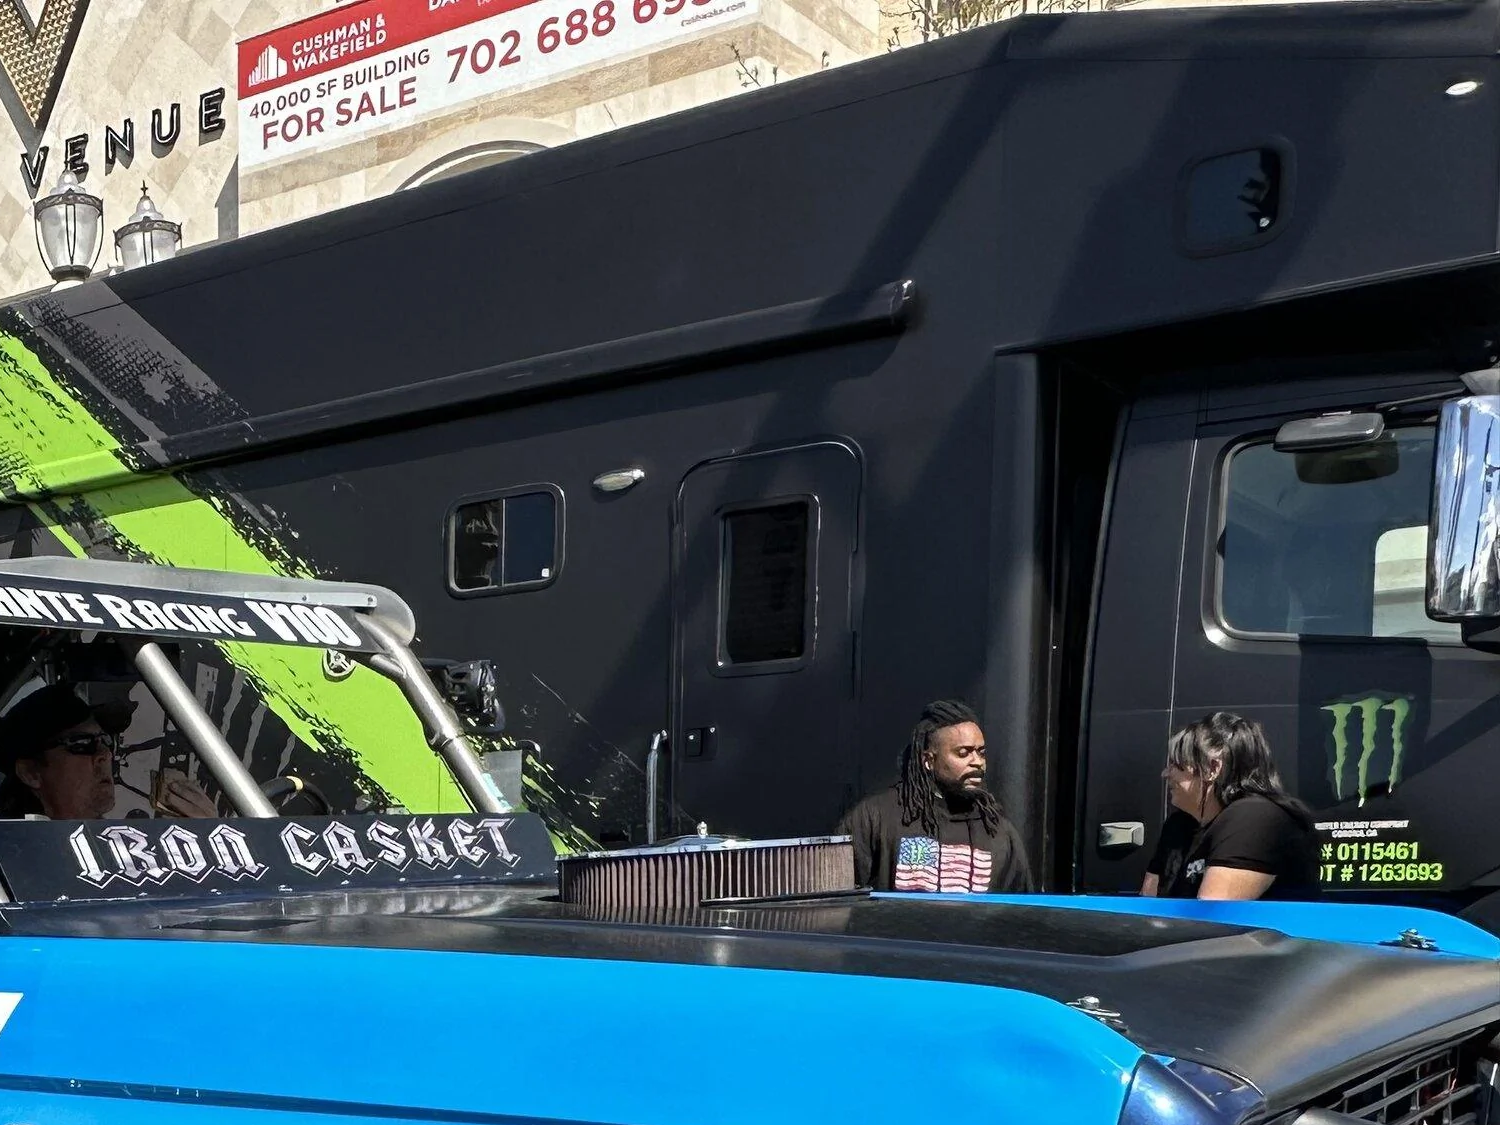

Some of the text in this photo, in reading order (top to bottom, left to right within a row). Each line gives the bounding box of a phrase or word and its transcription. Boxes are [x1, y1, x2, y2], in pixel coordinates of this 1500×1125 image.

[292, 13, 387, 55] CUSHMAN &
[292, 29, 388, 73] WAKEFIELD
[447, 29, 521, 84] 702
[537, 2, 616, 54] 688
[250, 49, 430, 120] 40,000 SF BUILDING
[263, 77, 417, 150] FOR SALE
[21, 87, 226, 196] VENUE
[98, 593, 256, 637] RACING
[245, 600, 364, 647] V100
[69, 817, 520, 889] IRON CASKET
[1337, 841, 1418, 861] 0115461
[1340, 864, 1354, 881] #
[1359, 863, 1443, 881] 1263693
